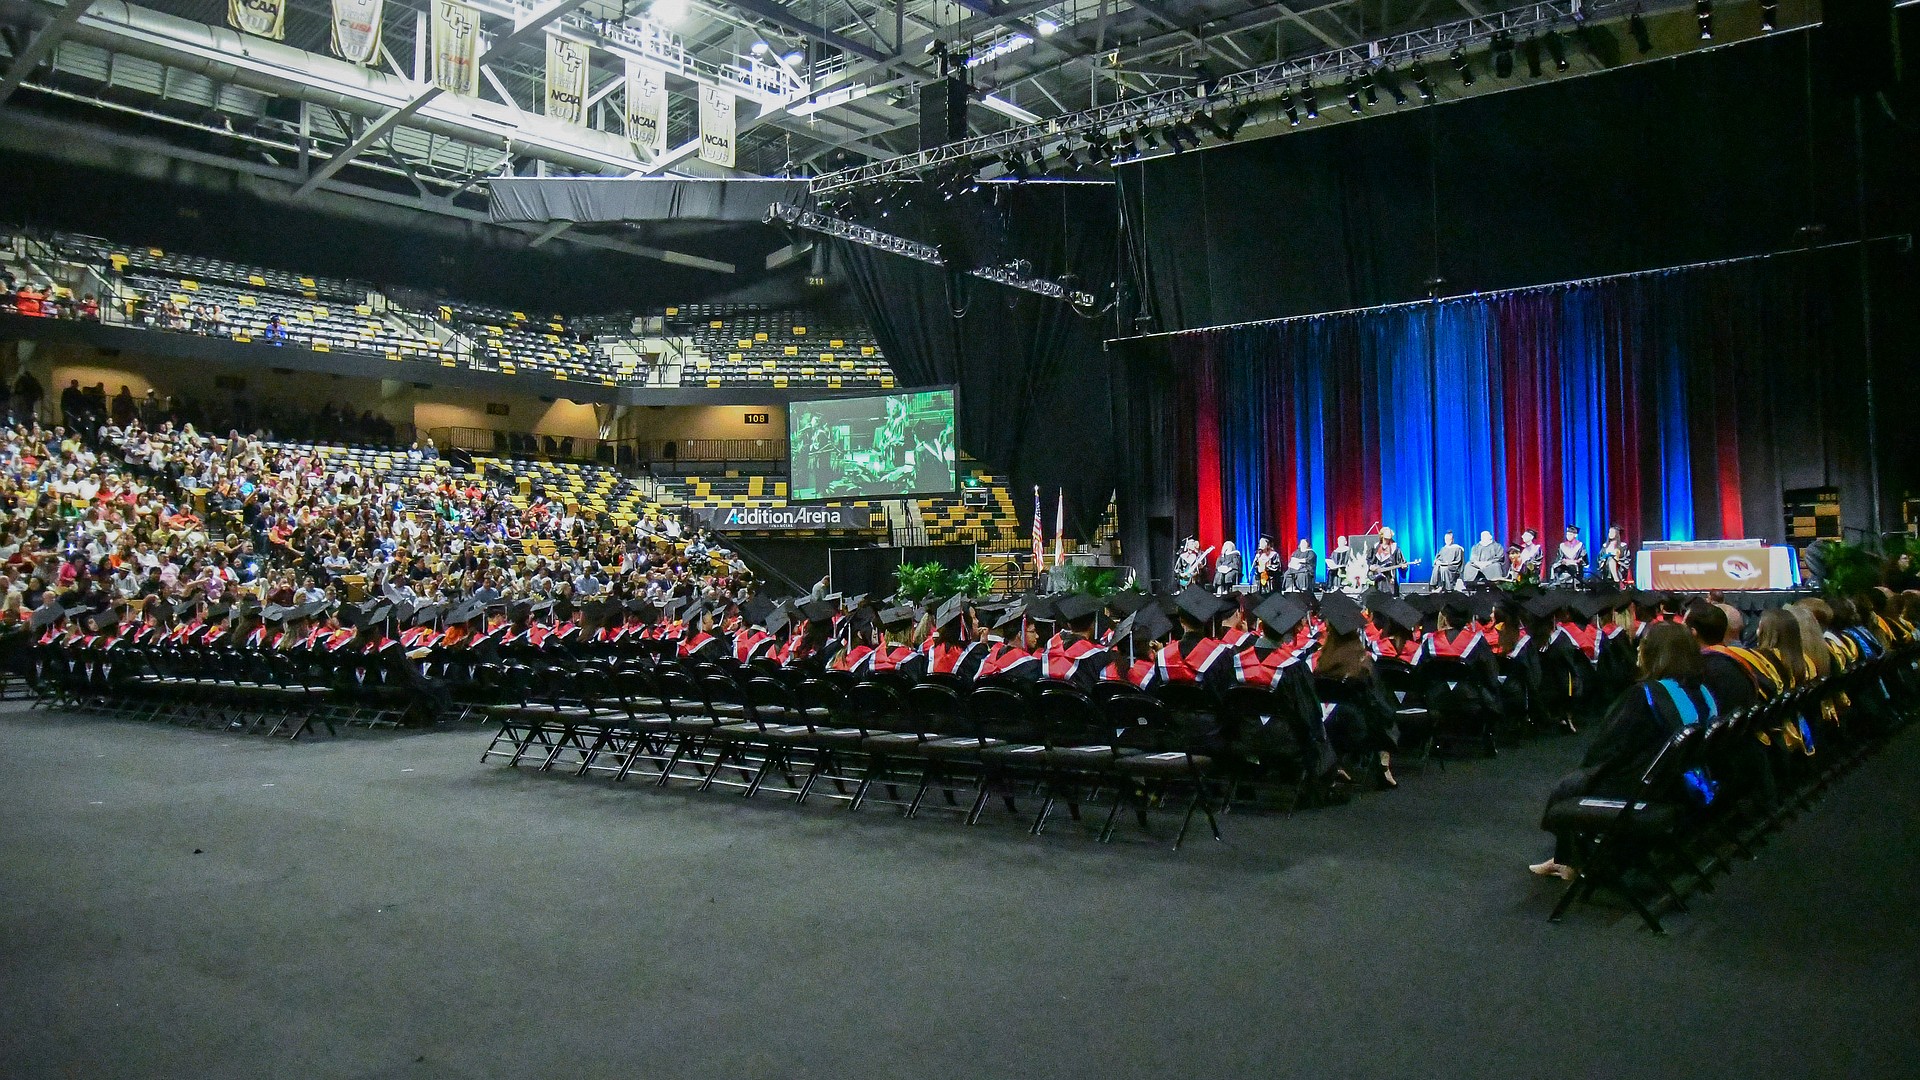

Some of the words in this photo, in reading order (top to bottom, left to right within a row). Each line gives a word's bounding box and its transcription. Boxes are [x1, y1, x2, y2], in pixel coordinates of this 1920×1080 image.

[441, 2, 472, 39] UCF
[555, 38, 583, 73] UCF
[551, 89, 580, 106] NCAA
[706, 87, 729, 118] UCF
[630, 113, 656, 130] NCAA
[705, 133, 728, 149] NCAA
[809, 277, 823, 285] 211
[748, 414, 765, 423] 108
[724, 508, 794, 525] Addition
[794, 507, 841, 524] Arena
